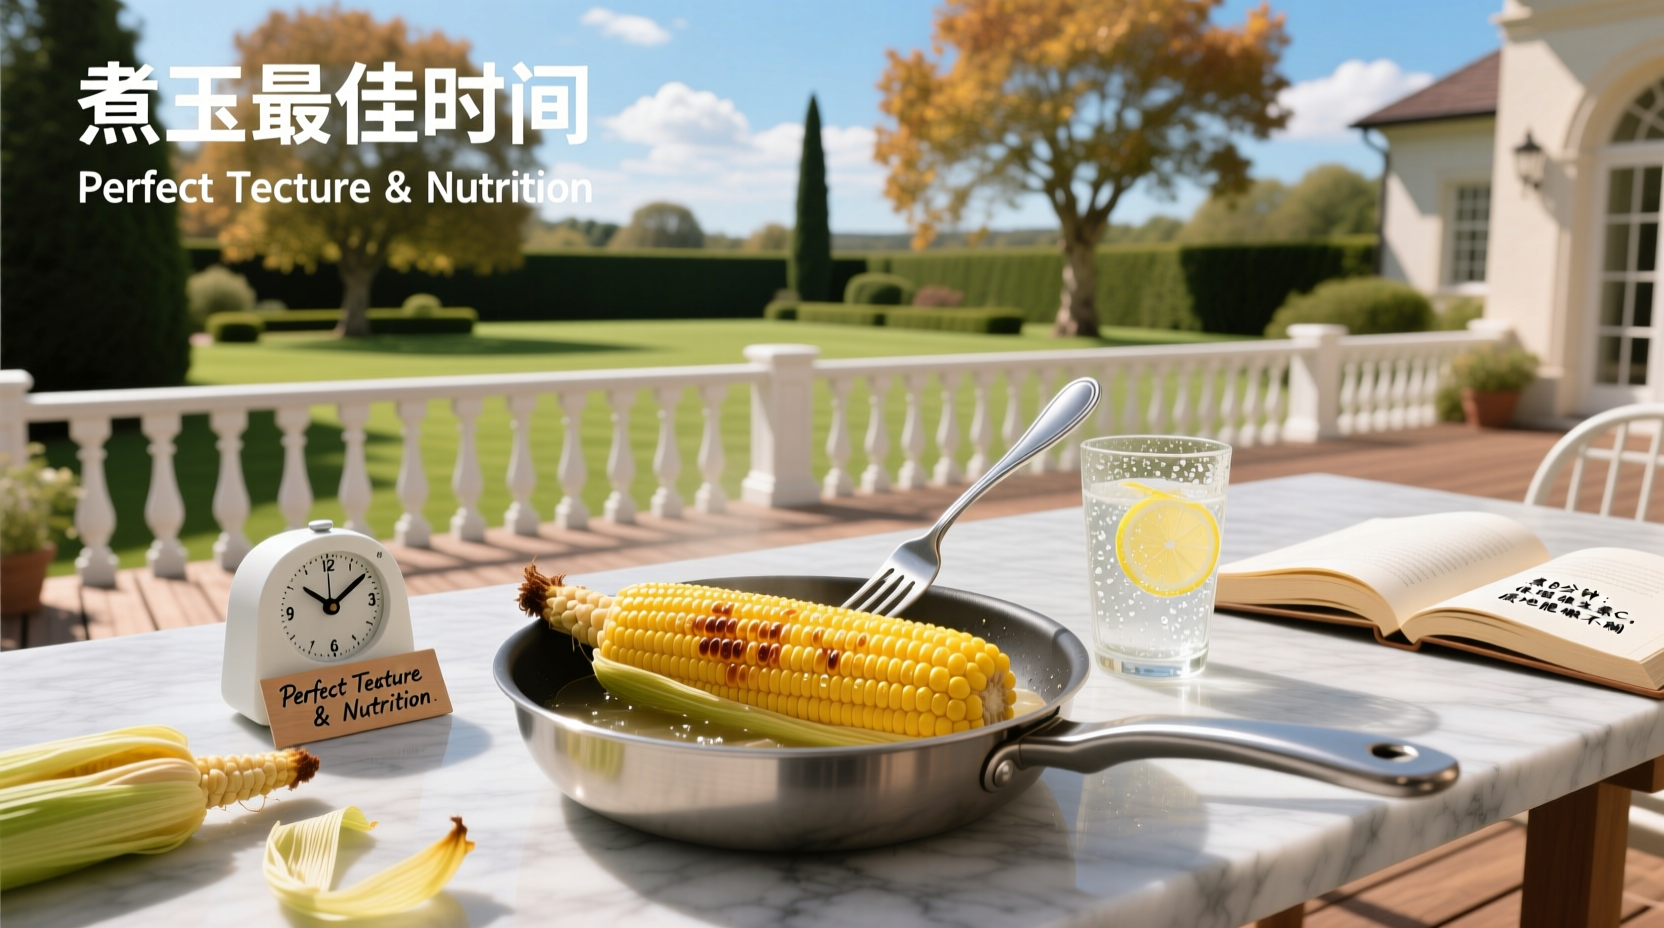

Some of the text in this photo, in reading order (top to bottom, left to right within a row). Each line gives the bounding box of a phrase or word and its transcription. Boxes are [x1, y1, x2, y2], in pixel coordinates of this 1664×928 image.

[322, 559, 335, 573] 12
[368, 592, 377, 607] 3
[286, 606, 295, 621] 9
[330, 639, 339, 653] 6
[279, 678, 348, 707] Perfect
[313, 705, 330, 727] &
